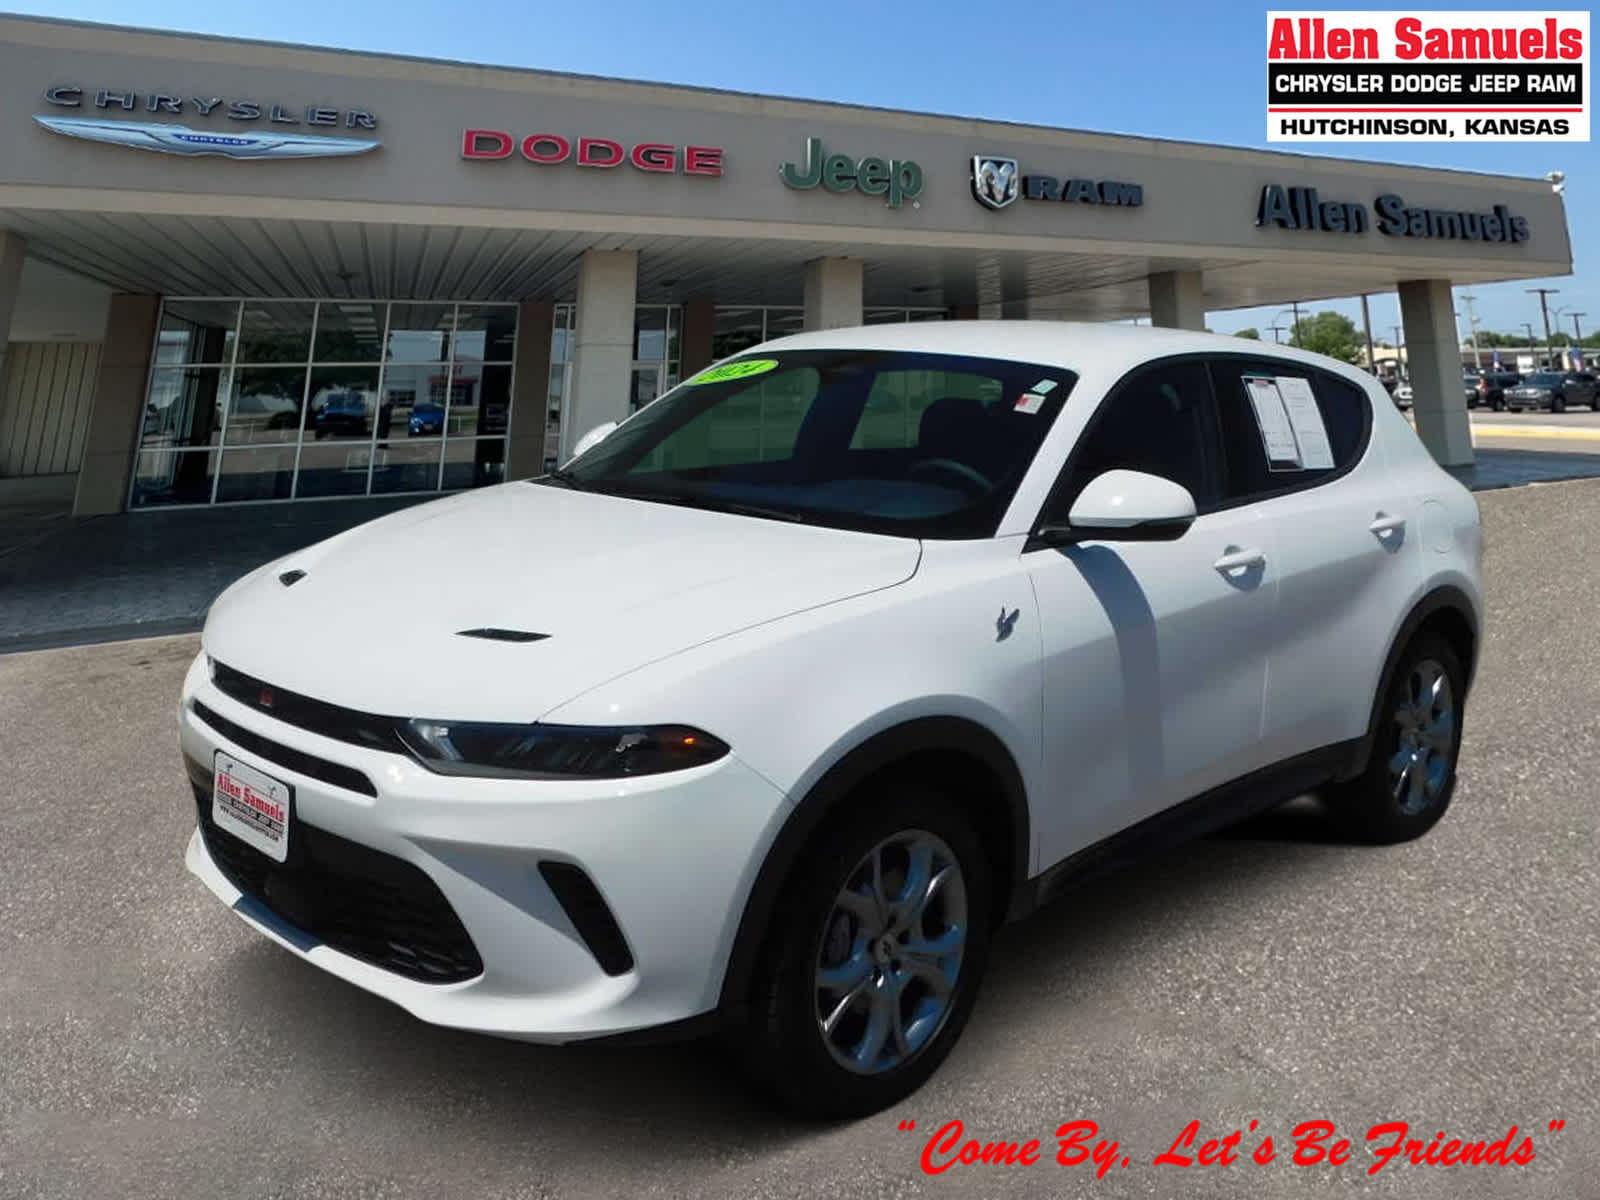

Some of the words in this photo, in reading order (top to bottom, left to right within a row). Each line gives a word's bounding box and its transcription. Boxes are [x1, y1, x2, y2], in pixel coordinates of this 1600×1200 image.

[44, 86, 377, 128] CHRYSLER
[462, 128, 725, 177] DODGE
[779, 136, 923, 210] Jeep
[1023, 175, 1144, 207] RAM
[1256, 184, 1369, 233] Allen
[1374, 193, 1530, 243] Samuels
